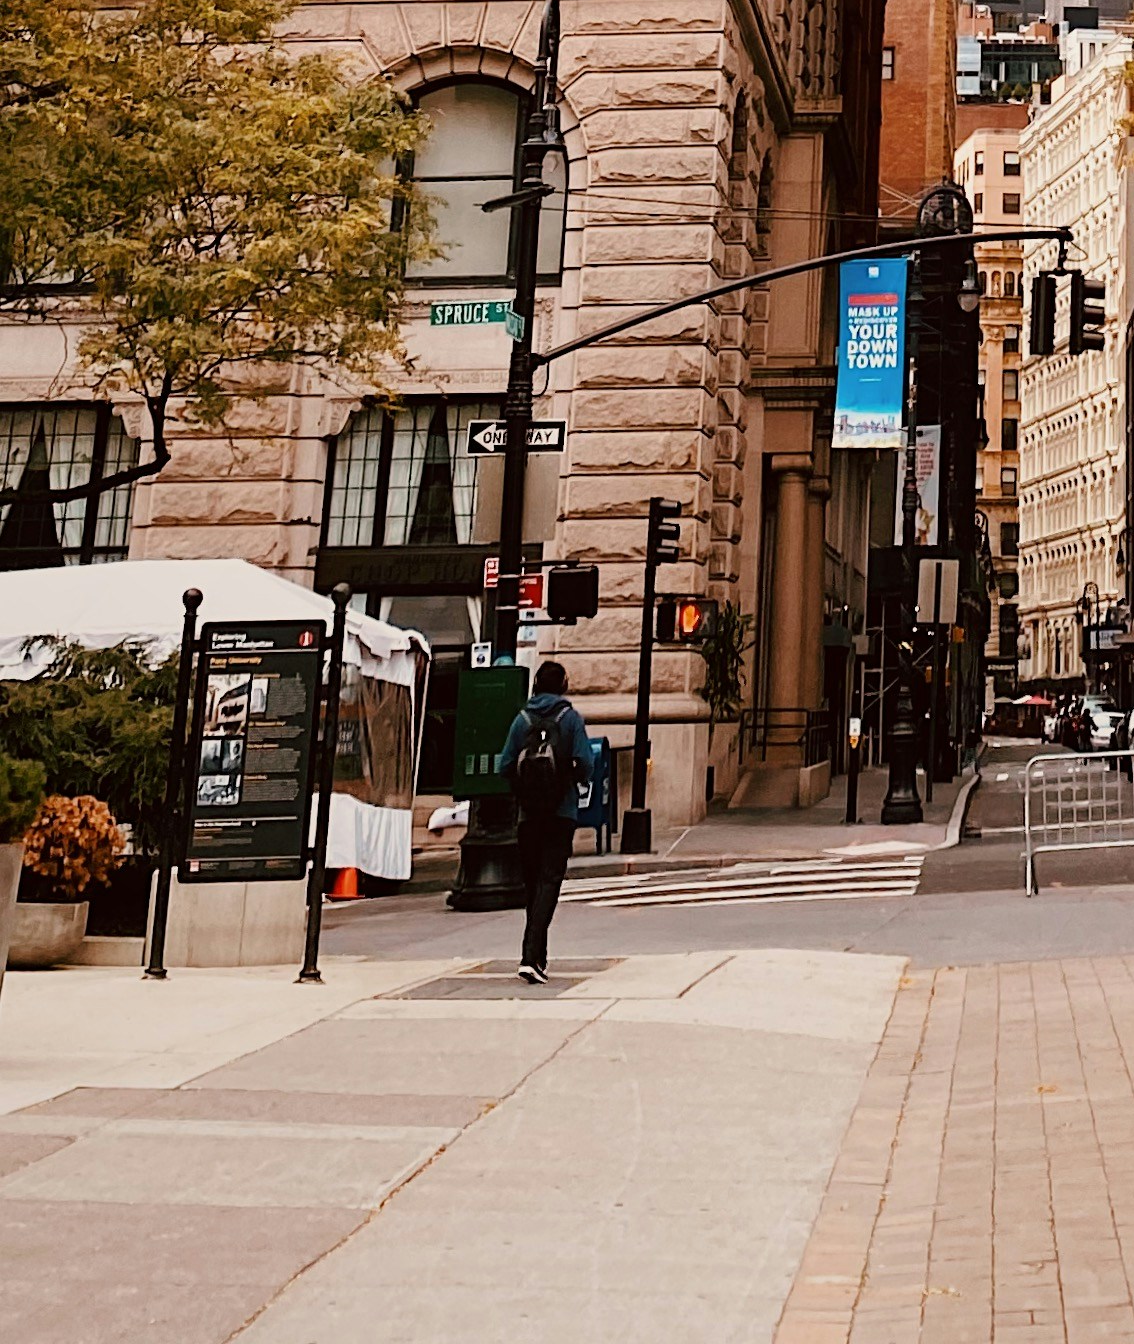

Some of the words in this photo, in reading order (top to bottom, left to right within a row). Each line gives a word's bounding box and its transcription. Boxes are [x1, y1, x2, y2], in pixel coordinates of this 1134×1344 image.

[435, 304, 490, 325] SPRUCE
[496, 302, 510, 313] ST
[848, 307, 880, 317] MASK
[883, 306, 898, 316] UP
[848, 324, 898, 340] YOUR
[847, 339, 898, 355] DOWN
[847, 353, 898, 369] TOWN
